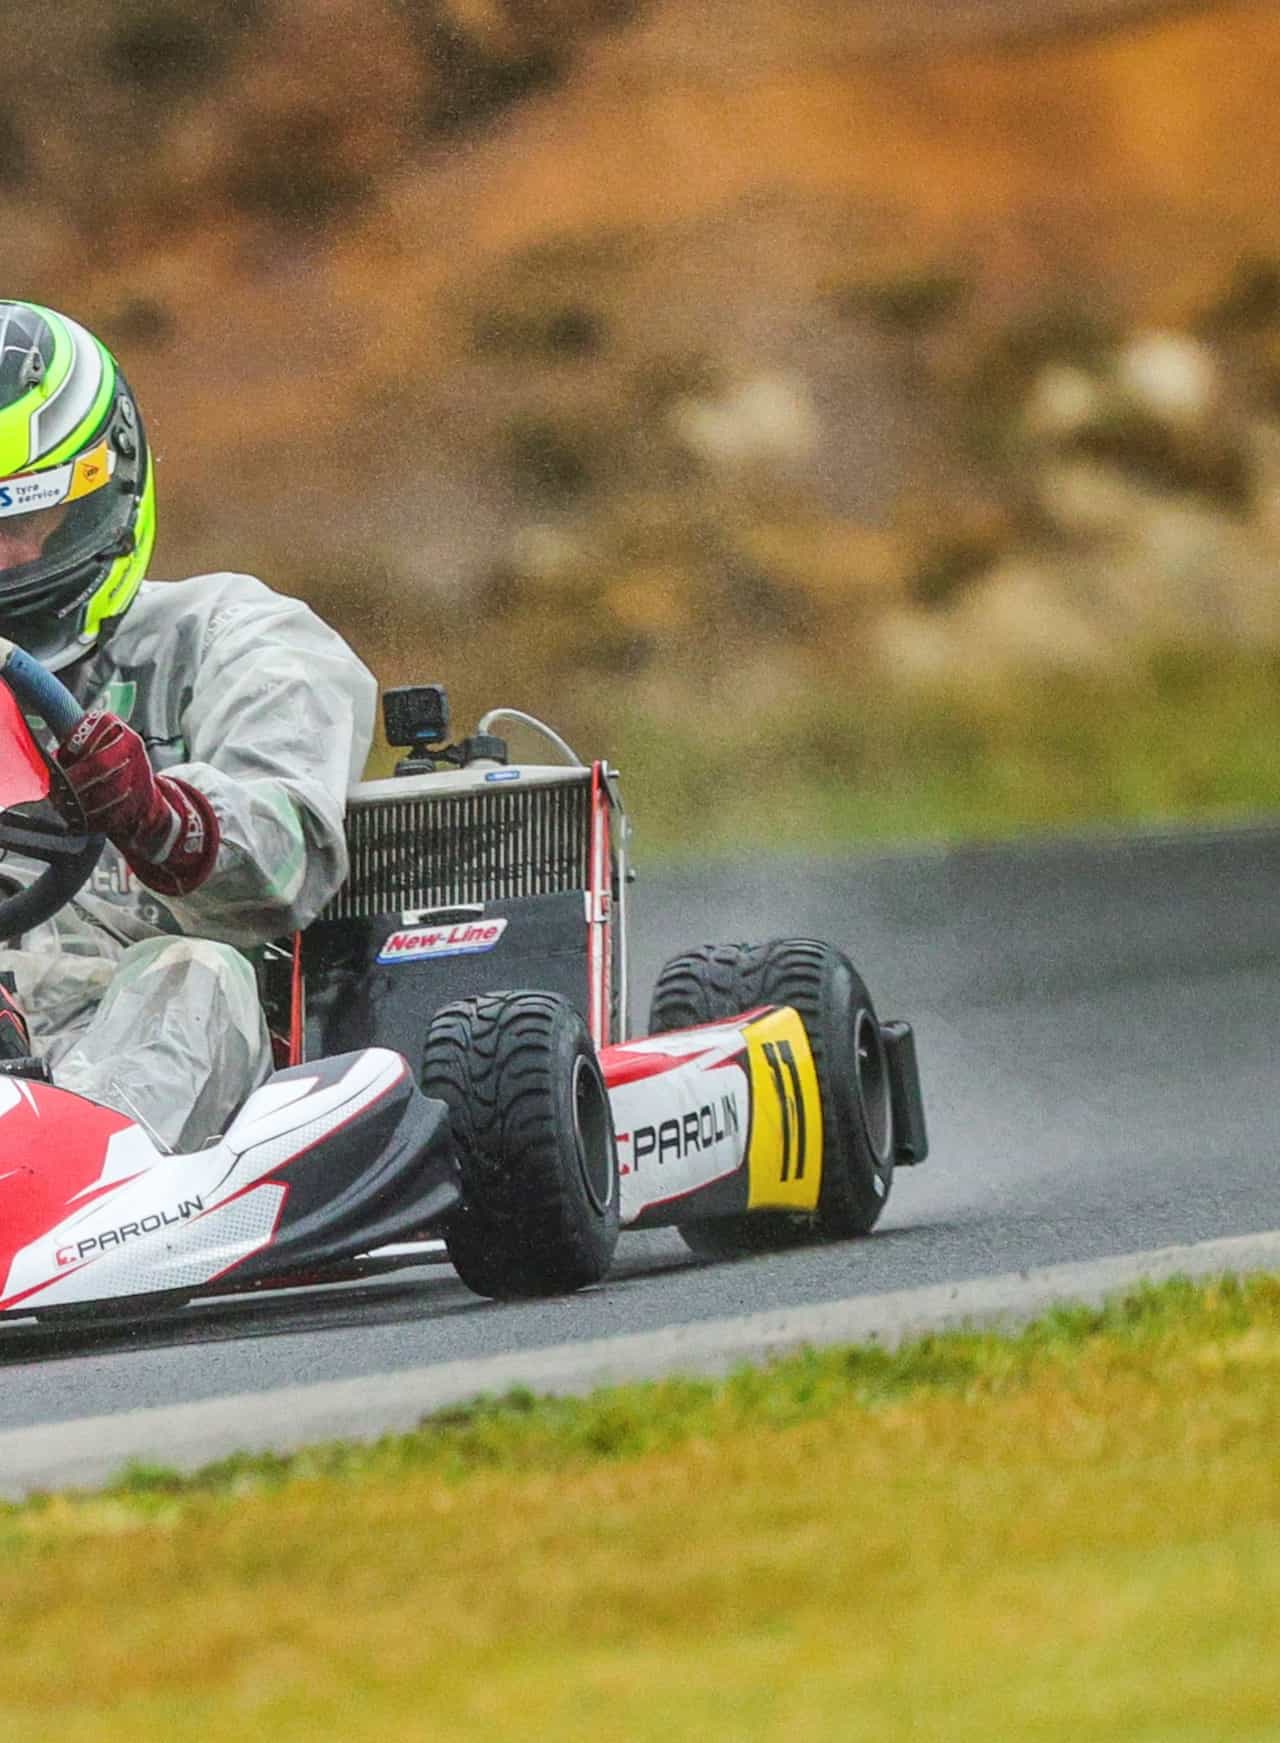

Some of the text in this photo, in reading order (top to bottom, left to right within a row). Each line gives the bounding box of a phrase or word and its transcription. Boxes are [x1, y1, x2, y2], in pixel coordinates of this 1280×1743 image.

[15, 484, 40, 496] tyre
[18, 487, 61, 503] service
[386, 924, 499, 952] New-Line
[632, 1091, 740, 1172] PAROLIN
[761, 1039, 807, 1183] 11
[76, 1194, 205, 1258] PAROLIN
